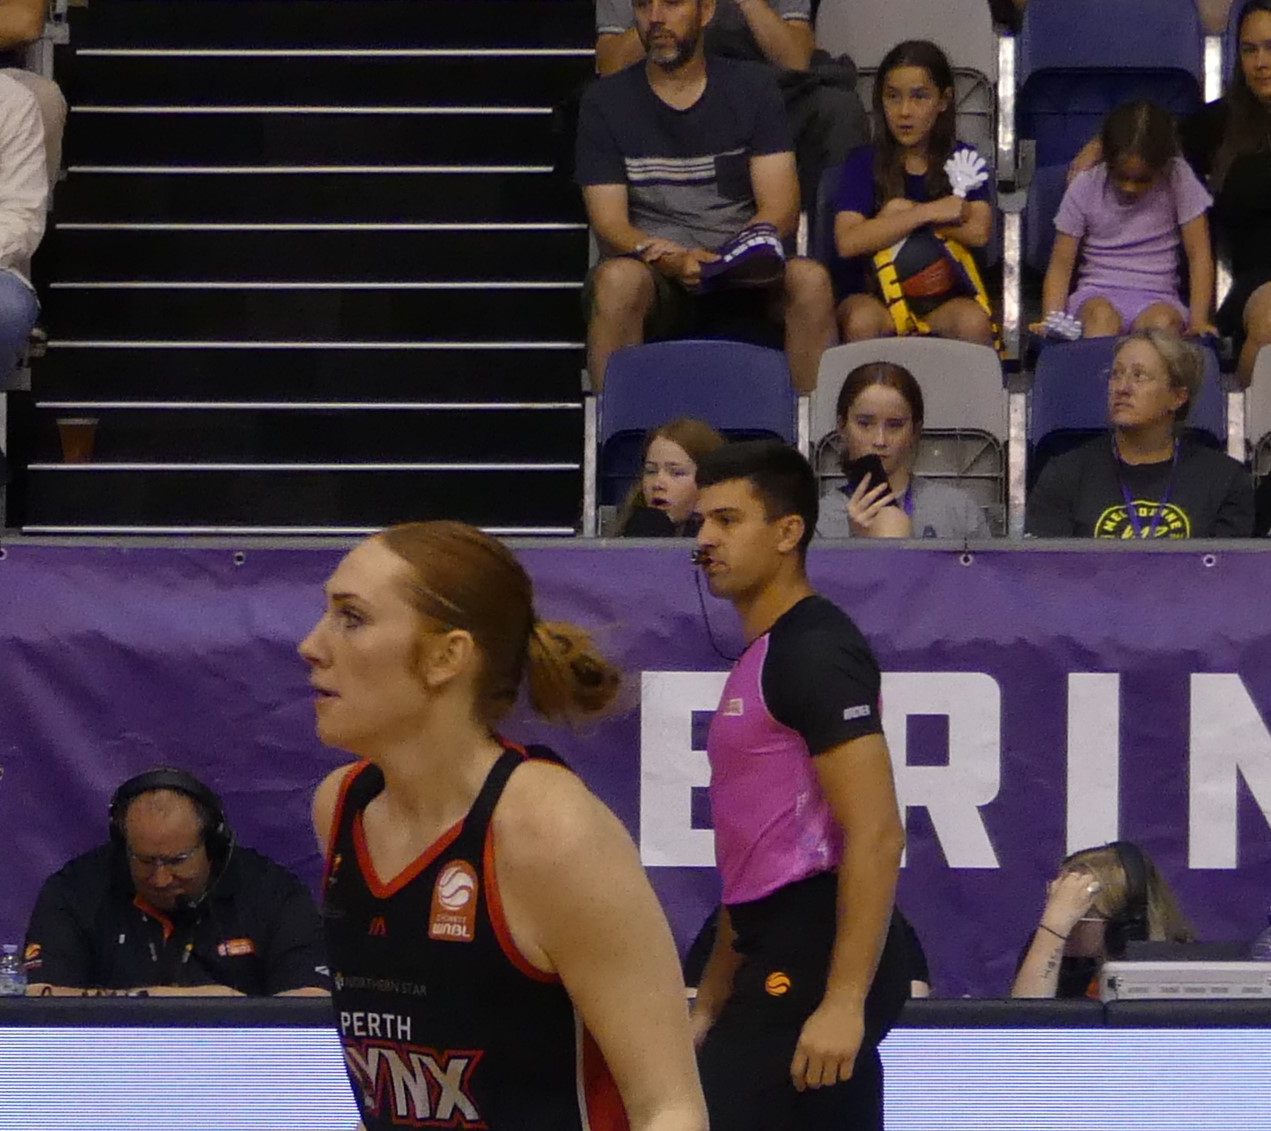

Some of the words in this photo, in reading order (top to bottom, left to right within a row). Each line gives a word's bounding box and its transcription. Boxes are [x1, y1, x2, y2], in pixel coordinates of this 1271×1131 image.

[432, 923, 471, 937] WNBL
[400, 983, 428, 996] STAR
[340, 1011, 412, 1042] PERTH
[343, 1047, 480, 1121] YNX
